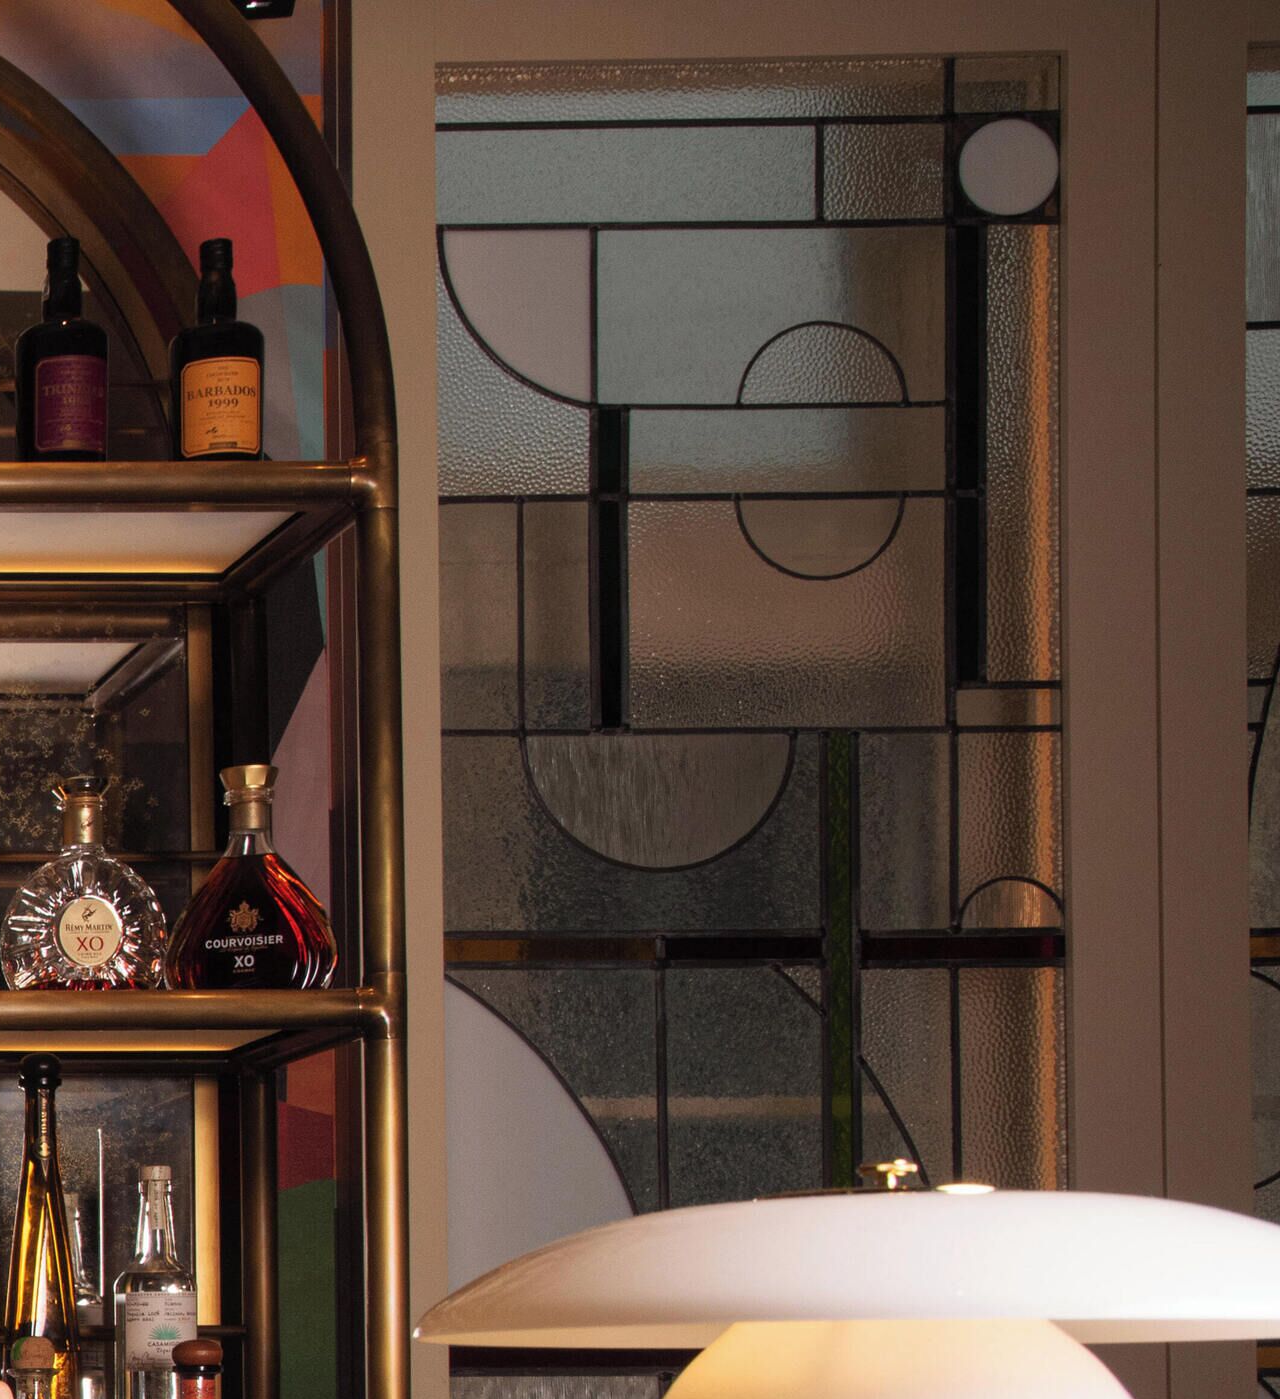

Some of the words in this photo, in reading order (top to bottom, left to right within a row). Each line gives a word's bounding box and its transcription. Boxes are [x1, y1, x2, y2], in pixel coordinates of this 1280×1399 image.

[187, 385, 256, 400] BARBADOS
[207, 399, 239, 408] 1999
[86, 923, 113, 931] MARTIN
[77, 936, 104, 951] XO
[205, 935, 284, 949] COURVOISIER
[234, 955, 255, 968] XO
